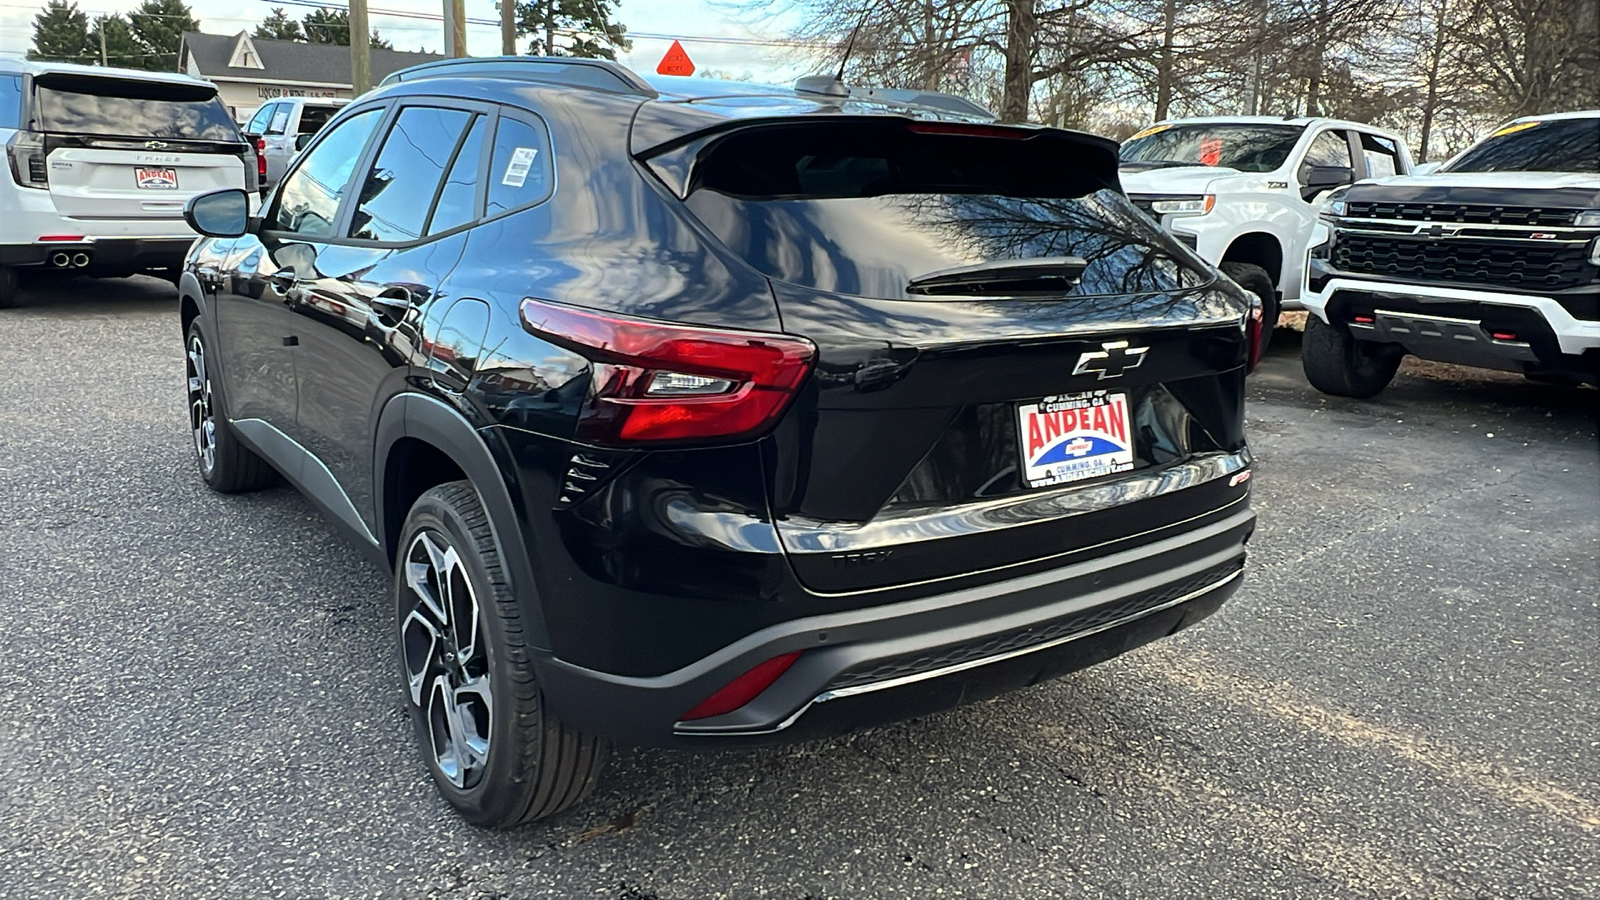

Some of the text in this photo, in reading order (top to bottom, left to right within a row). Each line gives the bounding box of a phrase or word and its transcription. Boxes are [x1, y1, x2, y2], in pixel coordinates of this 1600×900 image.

[257, 87, 281, 100] LIQUOR
[289, 89, 306, 98] WINE
[139, 169, 175, 182] ANDEAN
[1091, 397, 1105, 407] GA
[1028, 400, 1127, 461] ANDEAN
